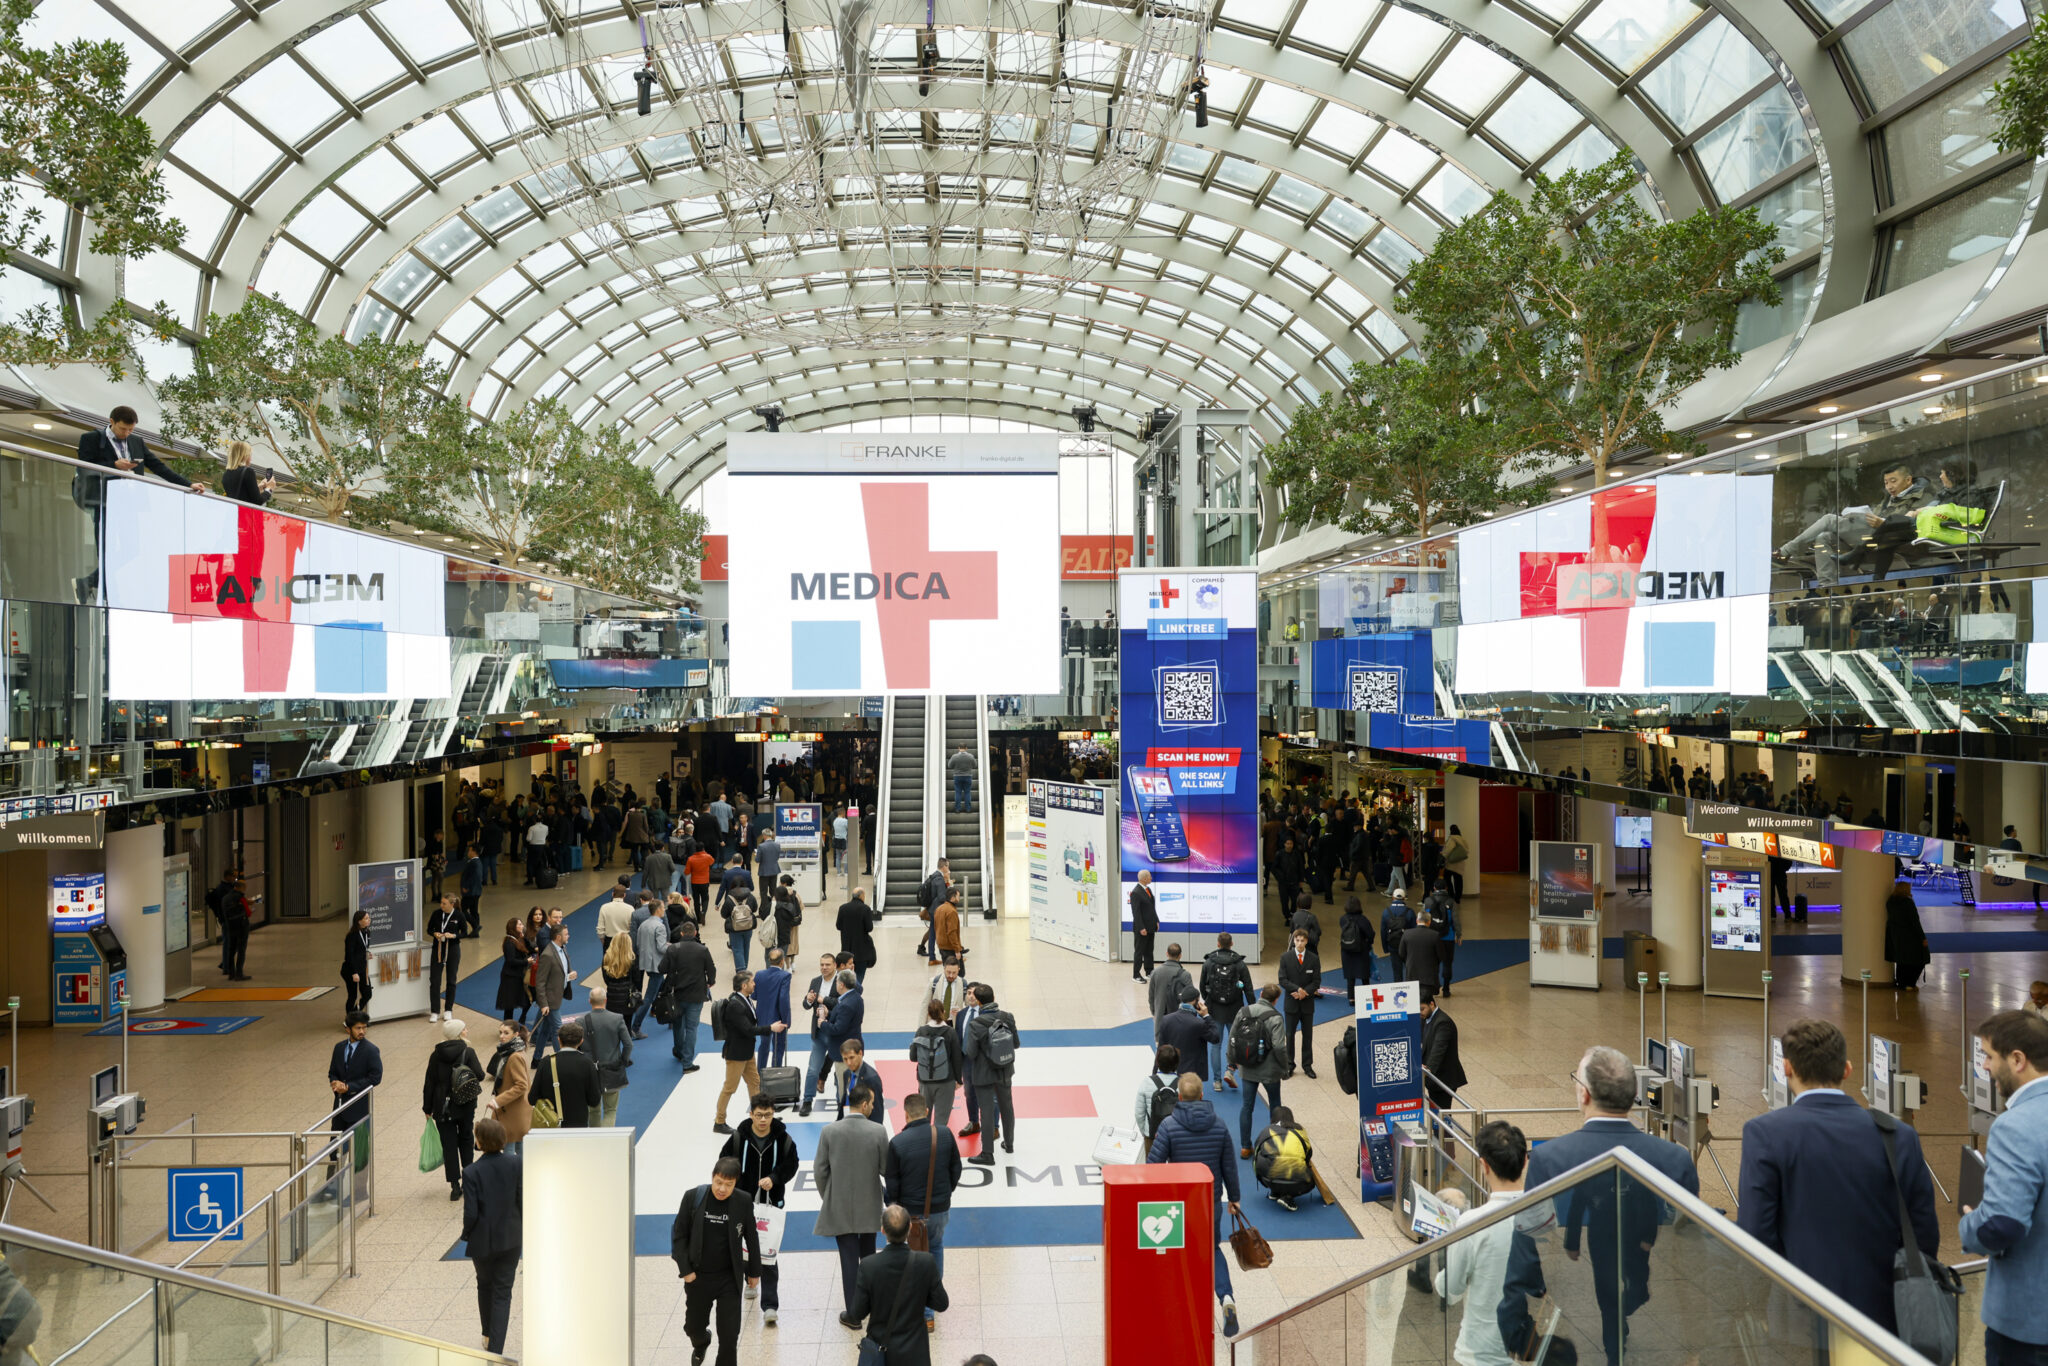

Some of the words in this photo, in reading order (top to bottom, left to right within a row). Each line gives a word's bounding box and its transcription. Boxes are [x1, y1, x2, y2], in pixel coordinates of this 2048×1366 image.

[865, 445, 946, 458] FRANKE
[1061, 547, 1129, 573] FAIR
[791, 571, 951, 600] MEDICA
[1159, 623, 1215, 634] LINKTREE
[1157, 753, 1184, 762] SCAN
[1185, 753, 1200, 762] ME
[1202, 753, 1230, 762] NOW!
[1179, 772, 1197, 780] ONE
[1198, 772, 1221, 780] SCAN
[1199, 780, 1224, 788] LINKS
[1700, 805, 1739, 815] Welcome
[1747, 817, 1814, 828] Willkommen
[17, 832, 91, 843] Willkommen
[1543, 890, 1577, 898] healthcare
[363, 905, 390, 914] High-tech
[372, 916, 393, 924] medical
[1375, 1013, 1402, 1021] LINKTREE
